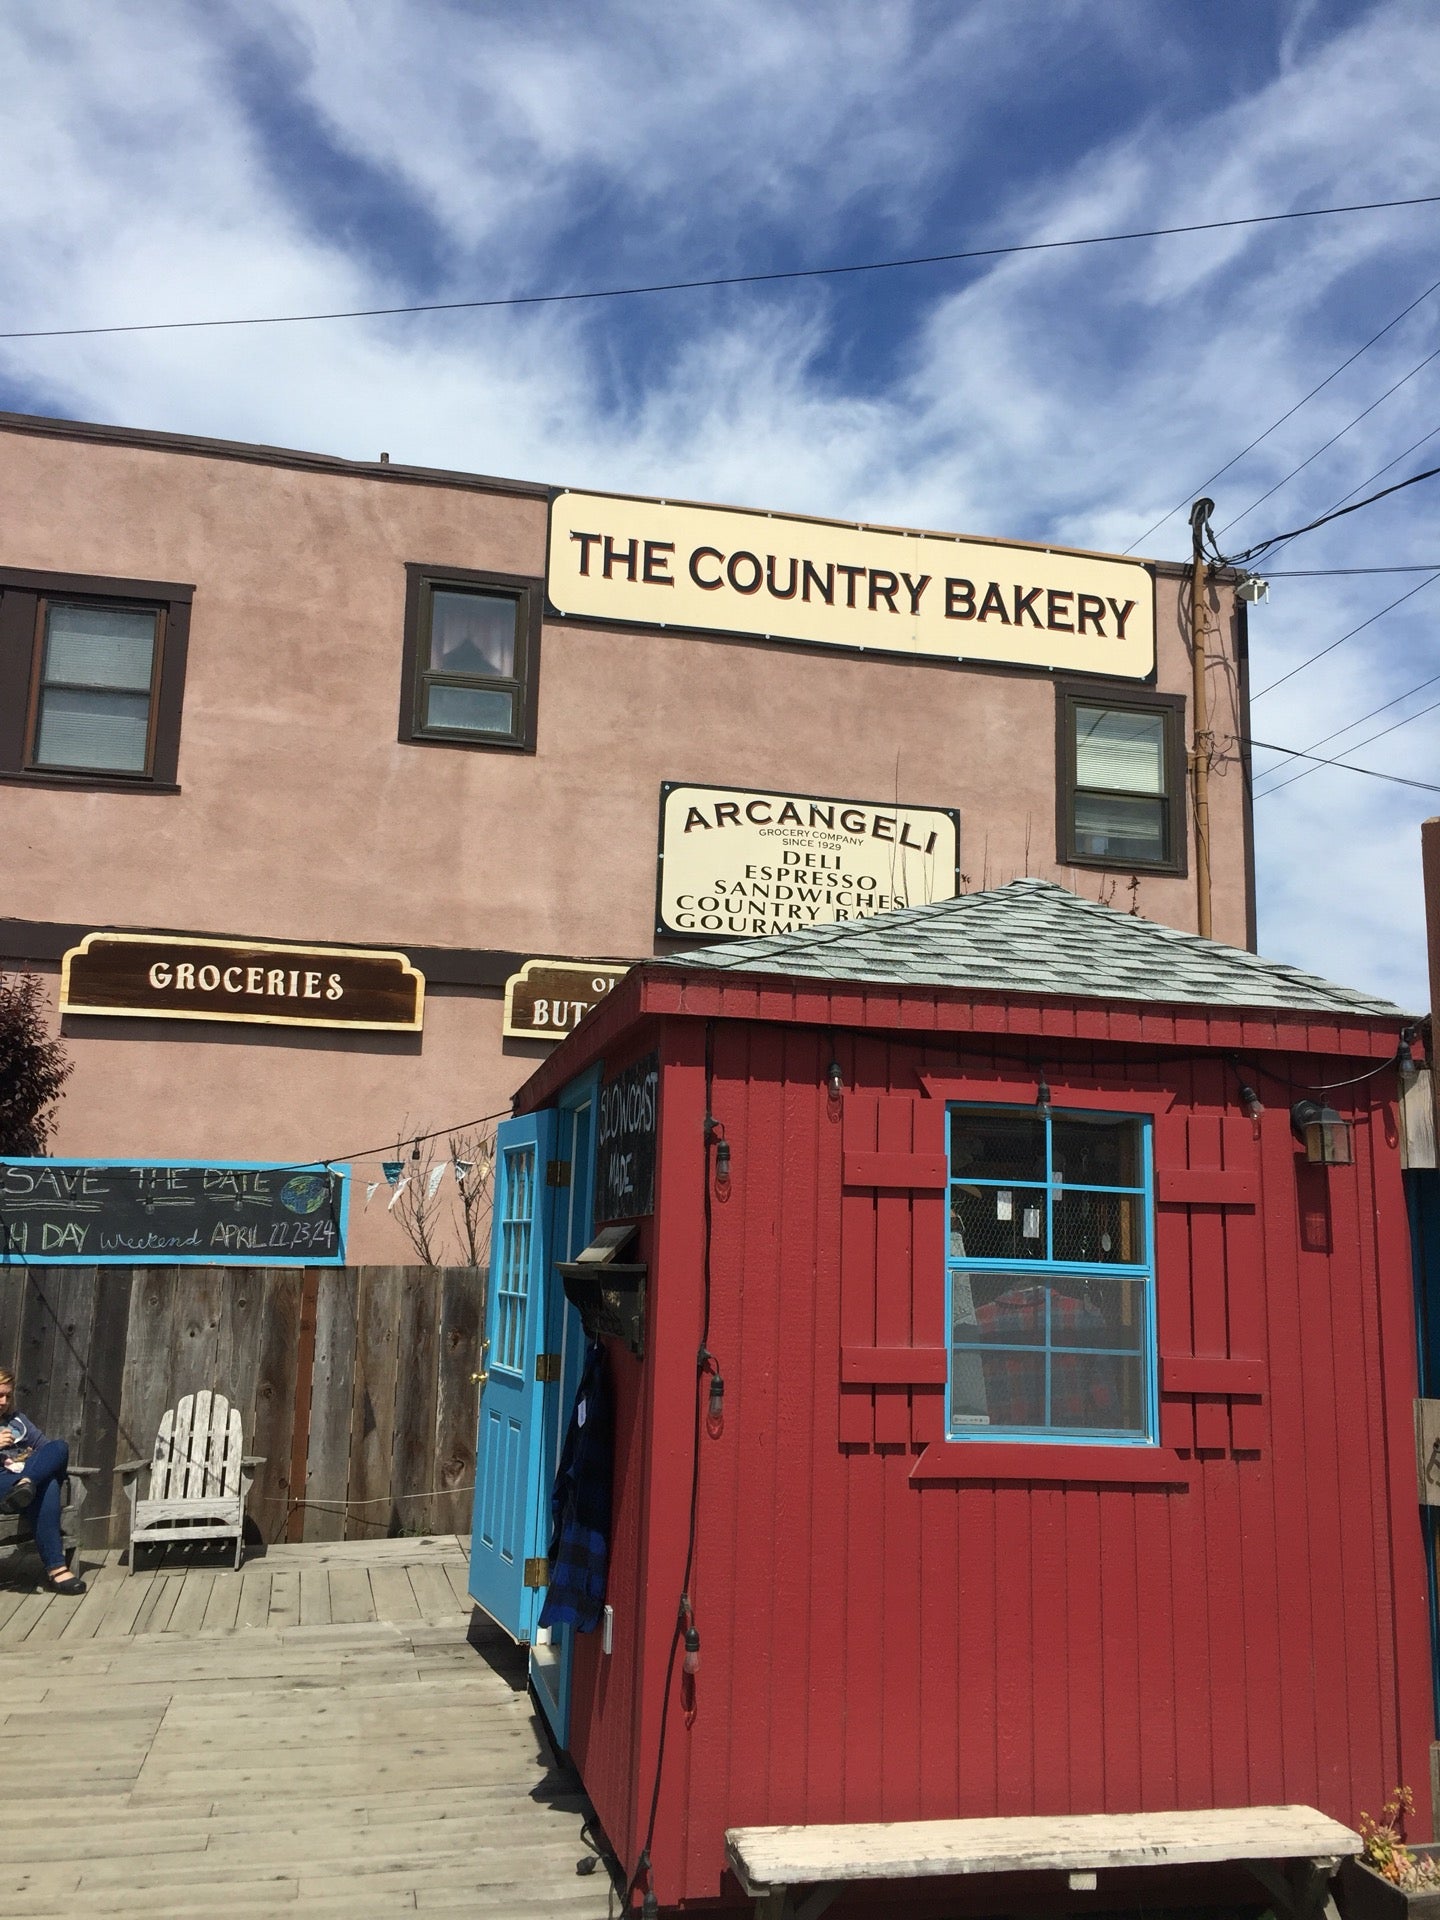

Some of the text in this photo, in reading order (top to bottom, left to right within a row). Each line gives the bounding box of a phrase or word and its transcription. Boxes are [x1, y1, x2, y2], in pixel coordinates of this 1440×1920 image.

[569, 530, 1137, 641] THE COUNTRY BAKERY
[683, 800, 938, 855] ARCANGELI
[759, 828, 865, 847] GROCERY COMPANY
[782, 838, 842, 851] SINCE 1929
[782, 850, 842, 870] DELI
[745, 864, 877, 891] ESPRESSO
[675, 895, 821, 921] COUNTRY
[714, 879, 905, 911] SANDWICHES
[148, 961, 345, 1001] GROCERIES
[532, 999, 597, 1028] BUT
[3, 1167, 271, 1199] SAVE THE DATE
[608, 1152, 634, 1197] MADE
[42, 1222, 91, 1253] DAY
[210, 1221, 267, 1250] APRIL
